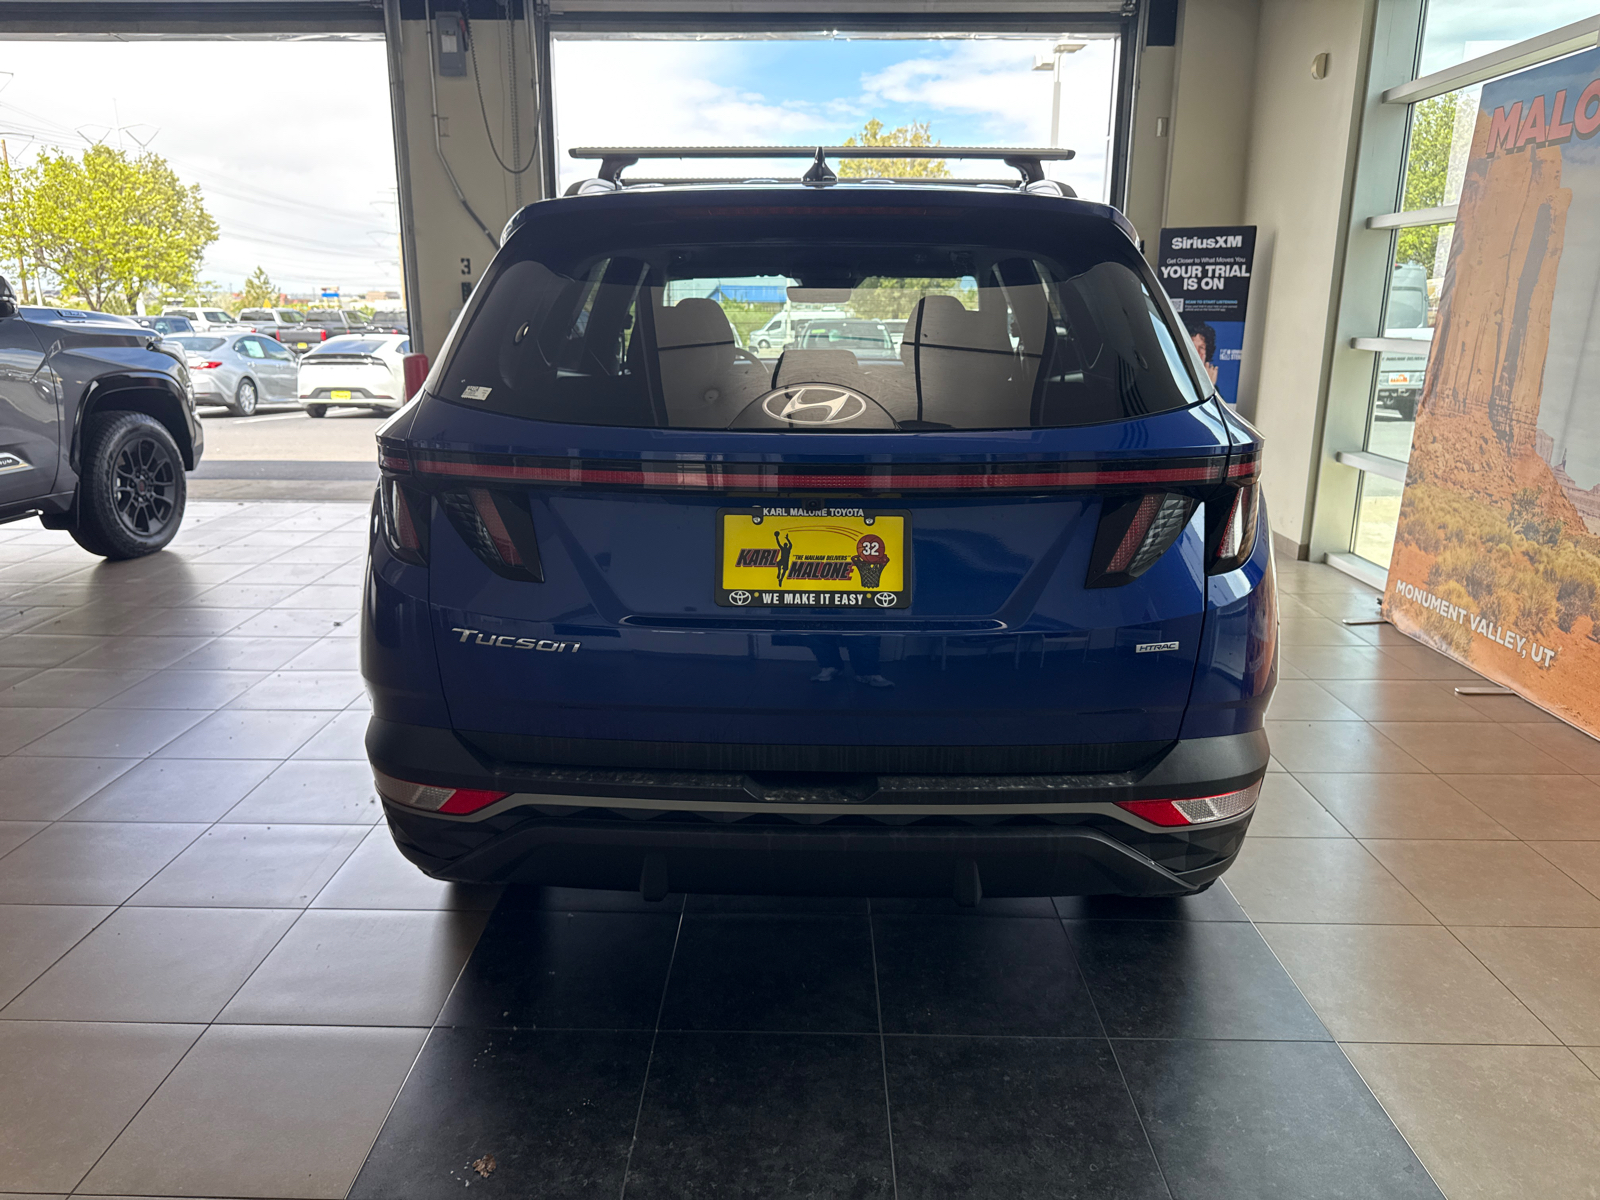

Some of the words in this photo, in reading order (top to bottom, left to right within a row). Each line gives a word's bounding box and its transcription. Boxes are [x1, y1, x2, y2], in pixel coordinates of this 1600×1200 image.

[1171, 235, 1243, 250] SiriusXM
[460, 257, 471, 275] 3
[1161, 265, 1202, 278] YOUR
[1205, 264, 1250, 277] TRIAL
[1183, 278, 1198, 290] IS
[1200, 277, 1225, 290] ON
[763, 507, 788, 516] KARL
[829, 508, 865, 517] TOYOTA
[862, 541, 880, 556] 32
[735, 548, 779, 567] KARL
[787, 560, 852, 580] MALONE
[762, 592, 780, 604] WE
[783, 593, 816, 605] MAKE
[820, 593, 831, 605] IT
[834, 593, 864, 605] EASY
[1395, 579, 1468, 625] MONUMENT
[1470, 613, 1527, 659] VALLEY,
[1530, 642, 1555, 668] UT
[1138, 642, 1178, 652] HTRAC
